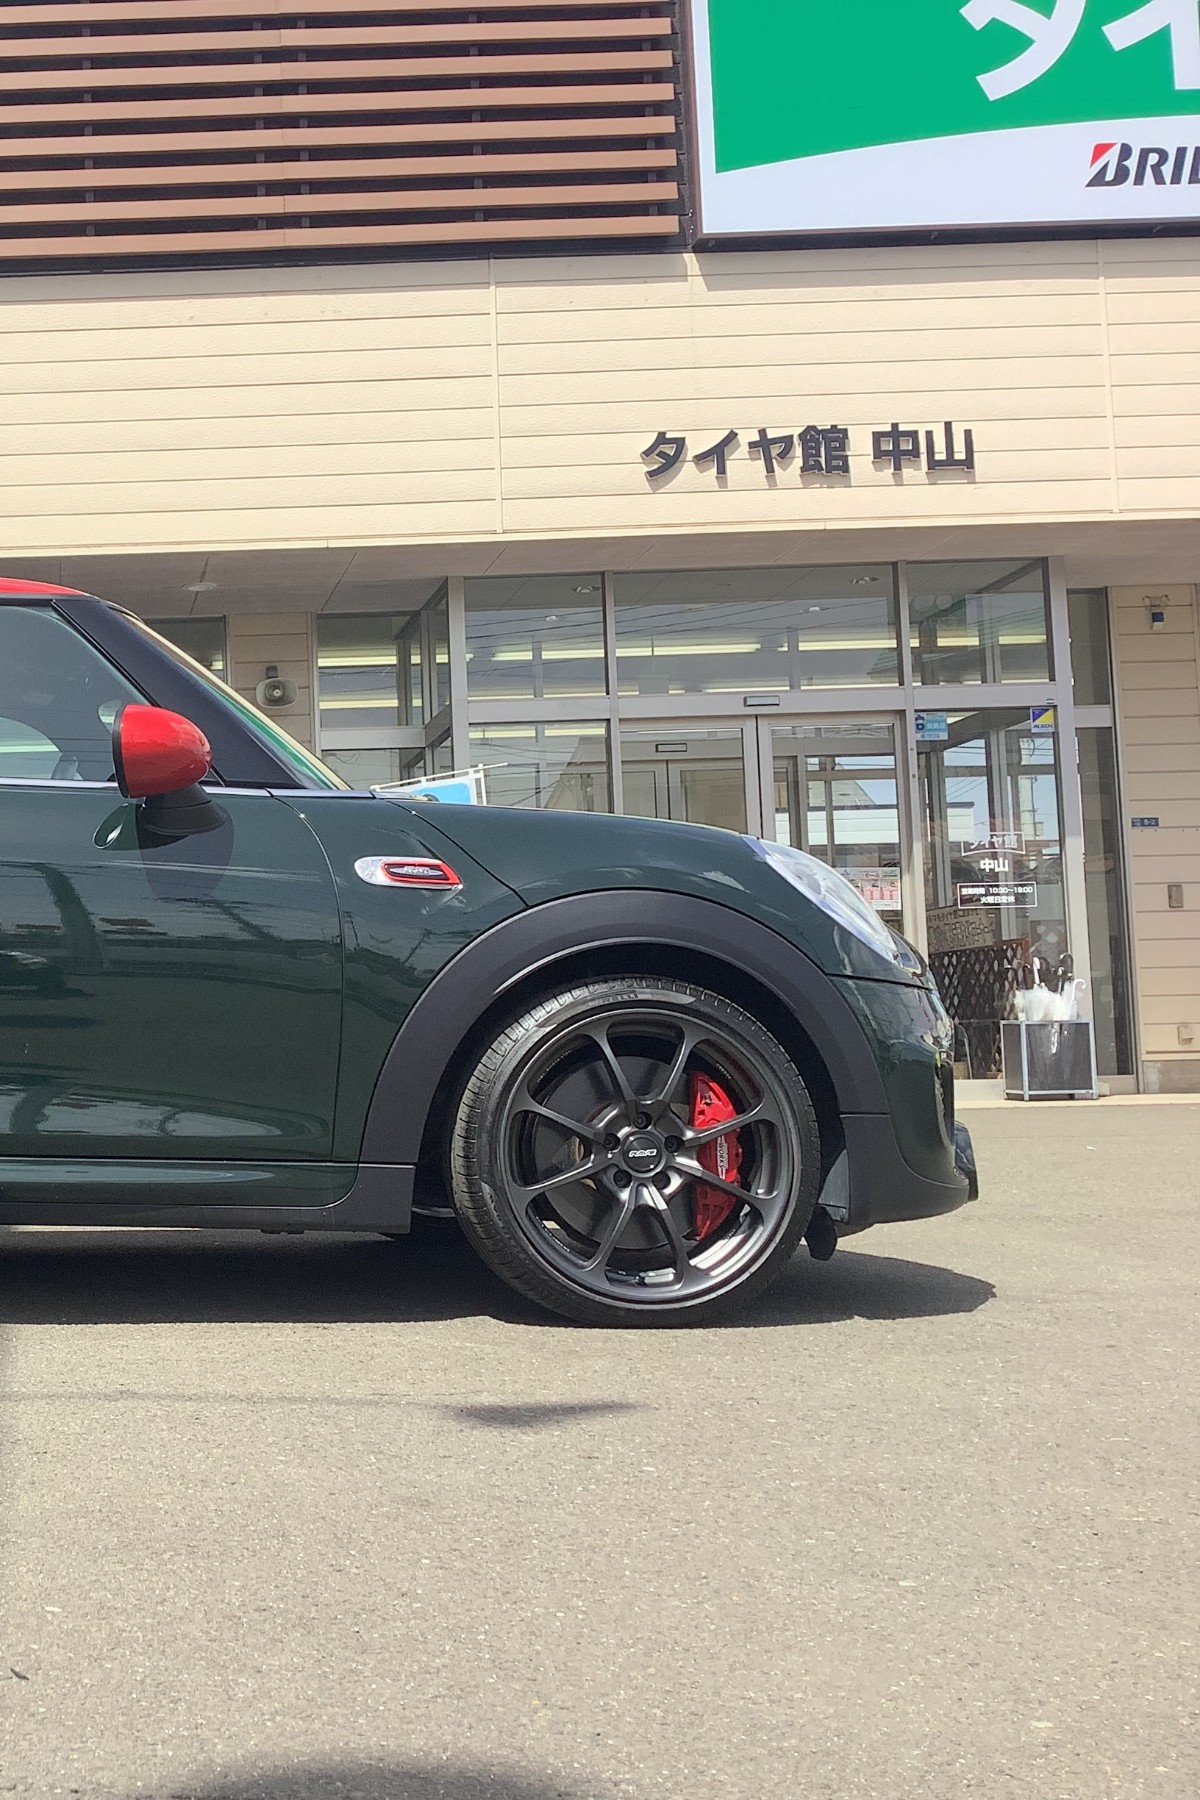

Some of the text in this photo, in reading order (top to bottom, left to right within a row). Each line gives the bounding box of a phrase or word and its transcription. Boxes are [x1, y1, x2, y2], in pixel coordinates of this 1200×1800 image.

[641, 422, 974, 479] タイヤ館 中山
[980, 857, 1009, 872] 中山
